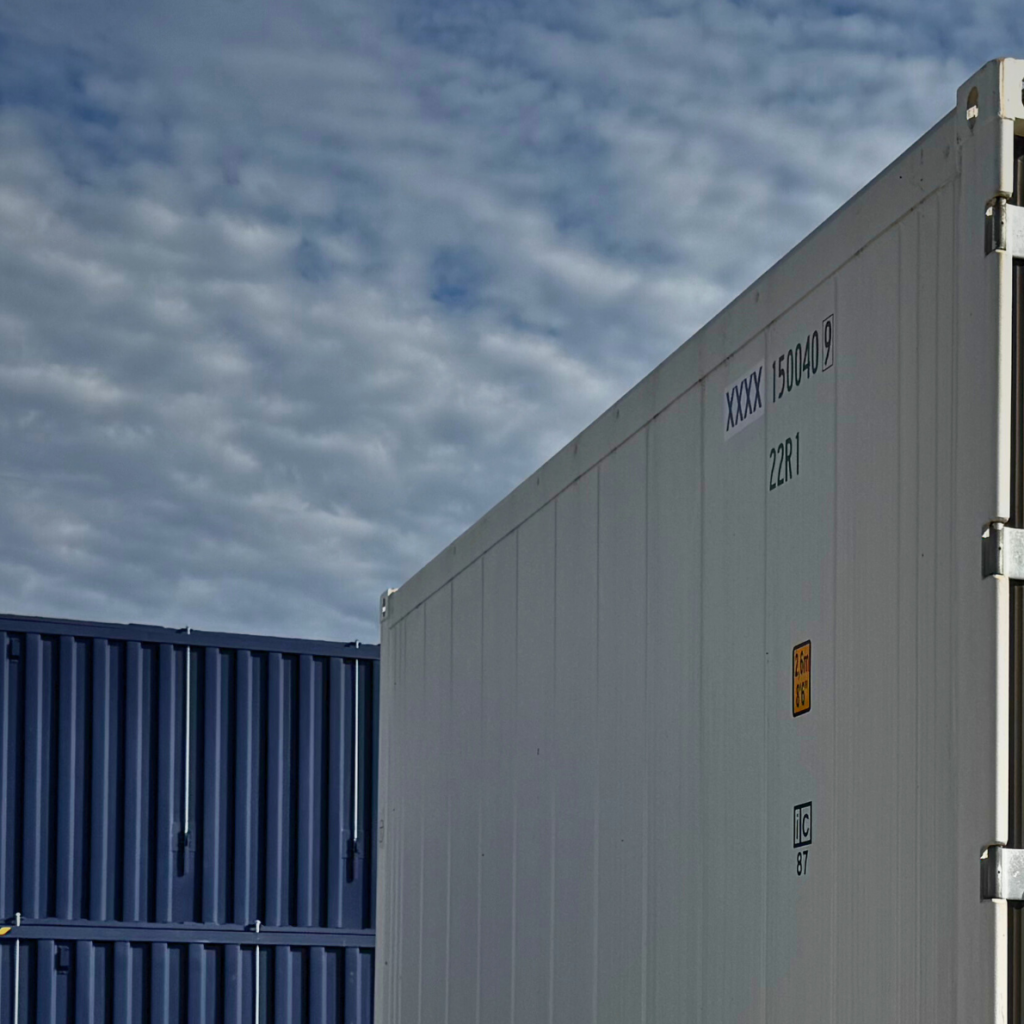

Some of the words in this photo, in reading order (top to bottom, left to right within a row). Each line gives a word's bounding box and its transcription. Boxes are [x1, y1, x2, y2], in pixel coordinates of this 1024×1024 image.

[726, 366, 763, 432] XXXX
[769, 431, 800, 491] 22R1
[796, 850, 809, 876] 87
